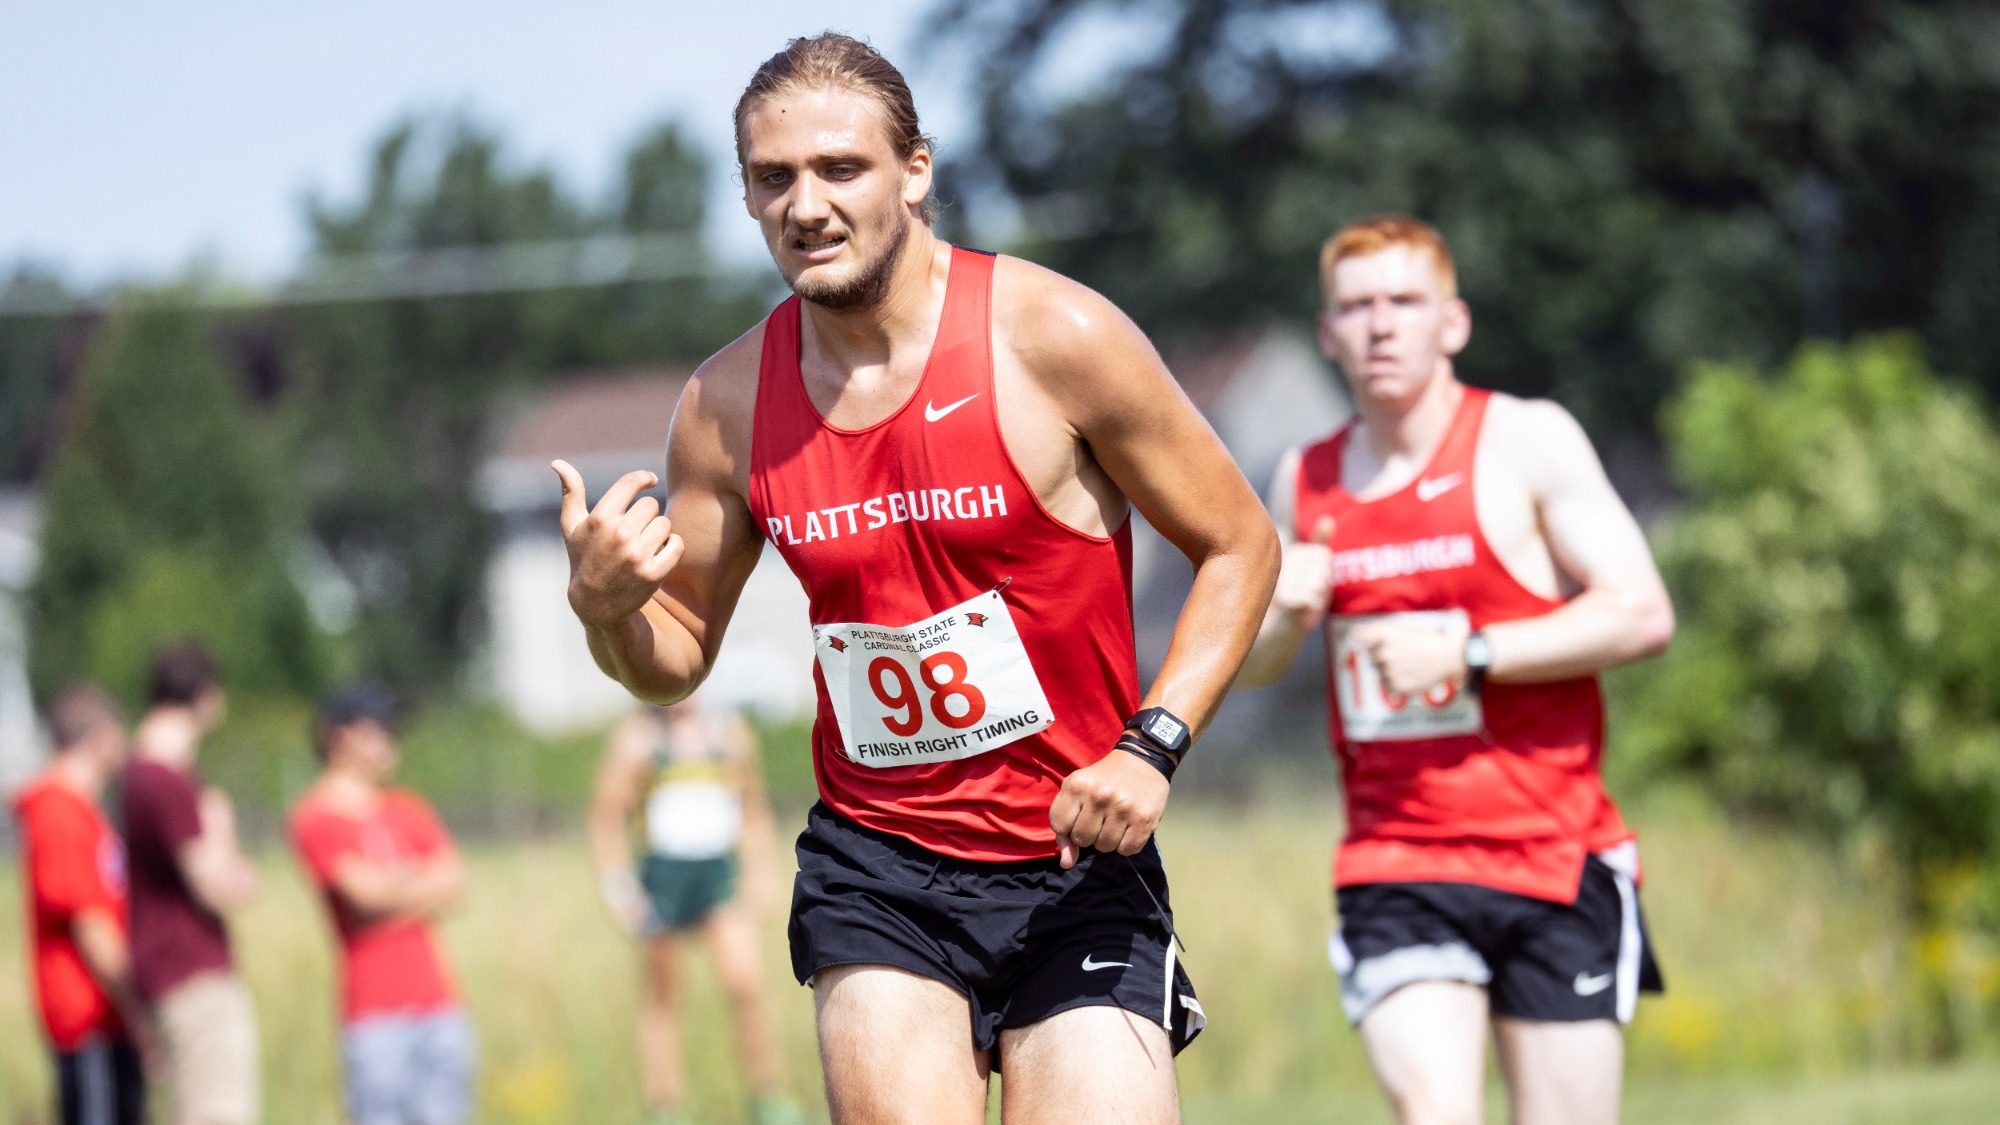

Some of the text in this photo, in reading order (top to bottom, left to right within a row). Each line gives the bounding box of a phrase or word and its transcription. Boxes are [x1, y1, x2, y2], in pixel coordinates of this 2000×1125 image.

[766, 484, 1008, 546] PLATTSBURGH
[1330, 534, 1475, 585] TTSBURGH
[851, 616, 957, 644] PLATTSBURGH STATE
[864, 632, 951, 653] CARDINAL CLASSIC
[867, 650, 986, 737] 98
[857, 710, 1039, 759] FINISH RIGHT TIMING
